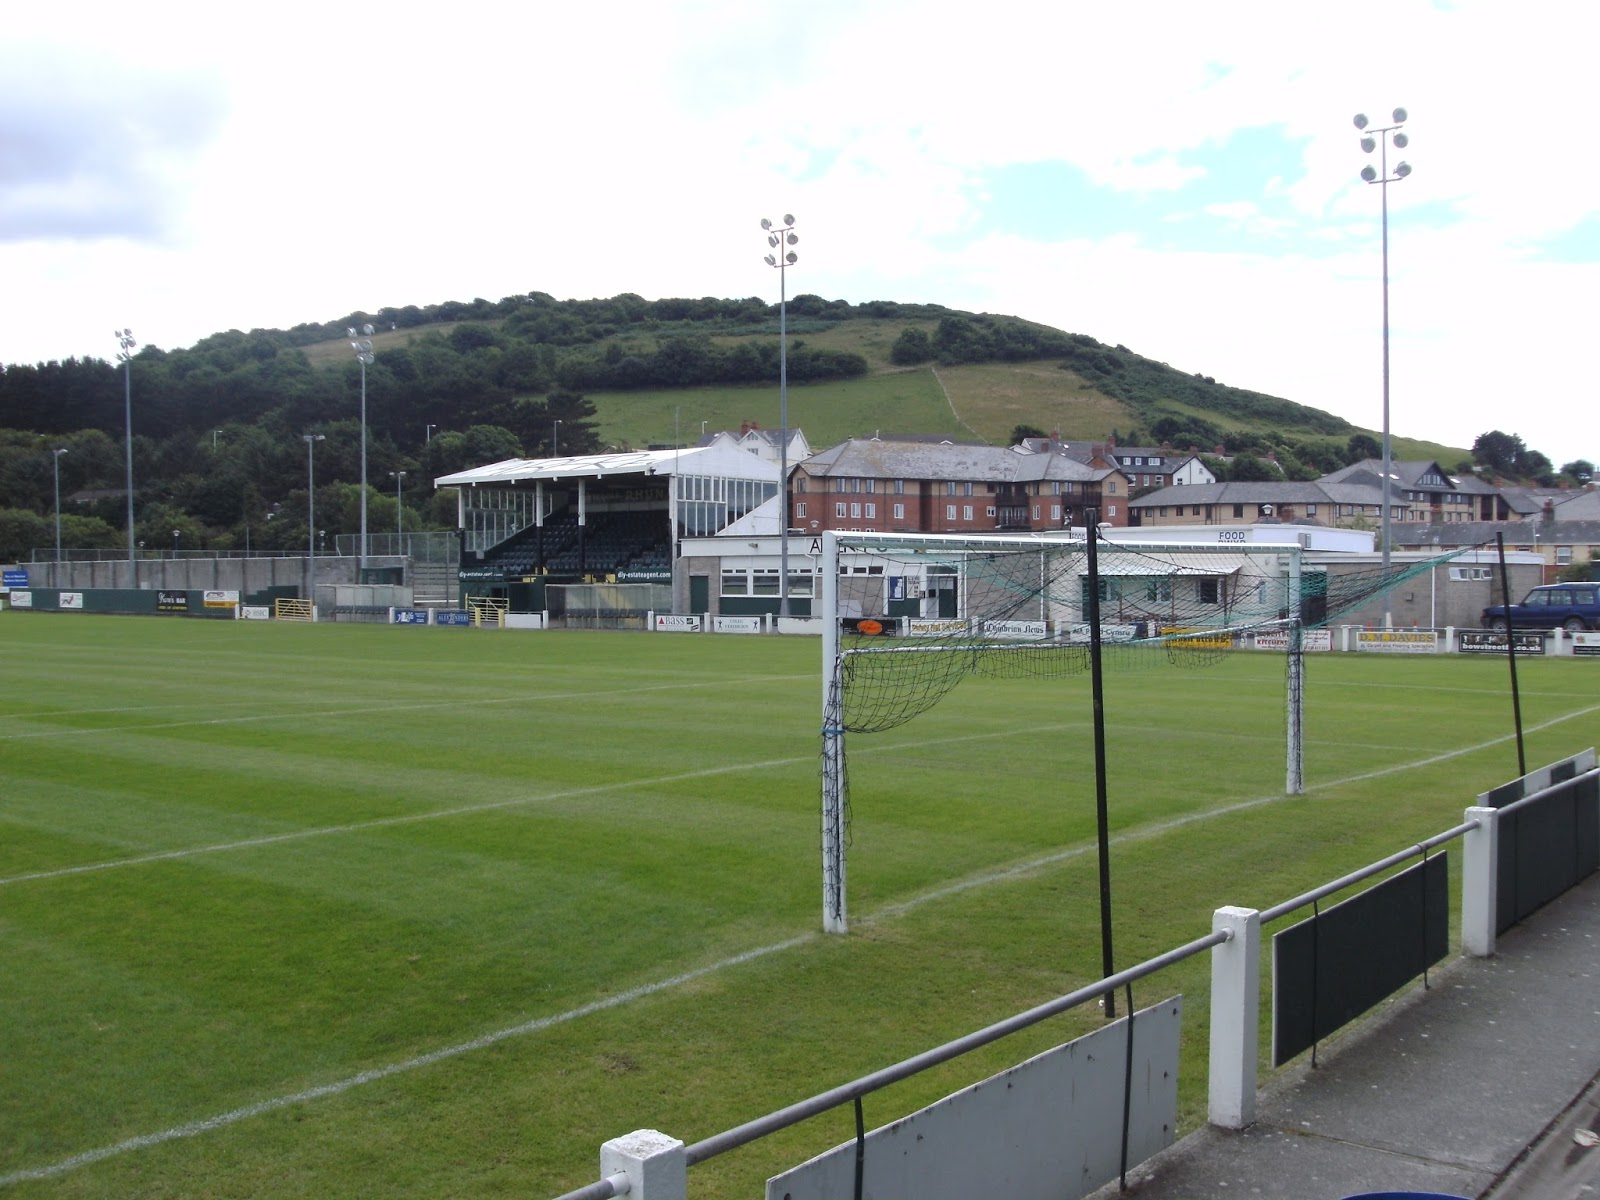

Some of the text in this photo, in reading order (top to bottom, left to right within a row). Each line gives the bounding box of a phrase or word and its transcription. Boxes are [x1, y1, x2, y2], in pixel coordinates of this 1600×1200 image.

[1219, 531, 1245, 540] FOOD
[618, 571, 671, 579] diy-estateagent.com
[1024, 623, 1044, 633] News
[1389, 633, 1434, 642] DAVIES
